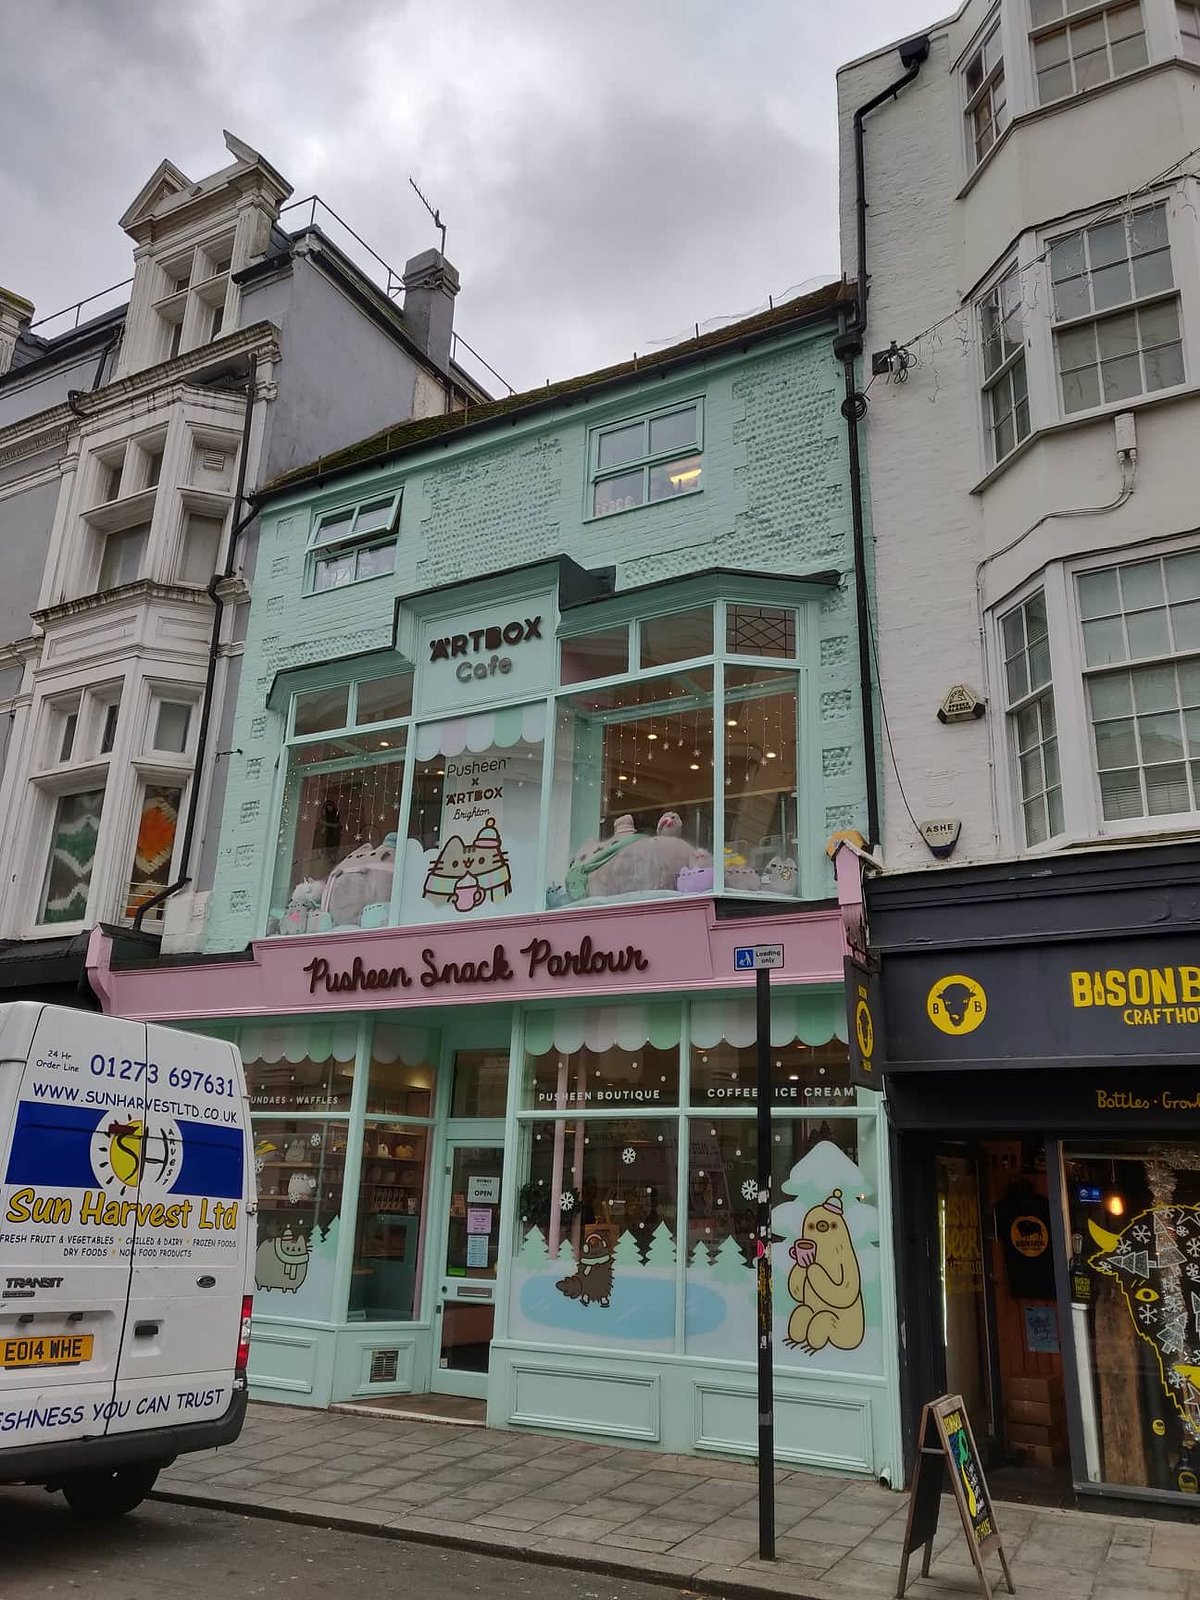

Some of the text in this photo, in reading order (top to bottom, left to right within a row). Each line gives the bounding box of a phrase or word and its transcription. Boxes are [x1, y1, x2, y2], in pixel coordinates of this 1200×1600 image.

[429, 615, 543, 662] ARTBOX
[456, 654, 513, 683] Cafe
[446, 759, 507, 778] Pusheen
[445, 786, 503, 806] ARTBOX
[453, 806, 490, 821] Brighton
[925, 823, 954, 833] ASHE
[303, 935, 649, 994] Pusheen Snack Parlour
[1123, 1007, 1200, 1025] CRAFTHO
[48, 1049, 72, 1060] 24 Hr
[36, 1059, 80, 1073] Order Line
[90, 1053, 234, 1098] 01273 697631
[251, 1095, 339, 1104] UNDAES WAFFLES
[539, 1089, 660, 1102] PUSHEEN BOUTIQUE
[707, 1086, 854, 1098] COFFEE ICE CREAM
[1096, 1090, 1150, 1109] Bottles
[474, 1189, 493, 1197] OPEN
[6, 1187, 238, 1230] Sun Harvest Ltd
[0, 1234, 237, 1248] FRESH FRUIT & VEGETABLES CHILLED & DAIRY FROZEN FOODS
[63, 1247, 192, 1258] DRY FOODS NON FOOD PRODUCTS
[6, 1277, 64, 1288] TRANSIT
[50, 1338, 83, 1358] WHE
[93, 1400, 130, 1421] YOU
[136, 1396, 170, 1414] CAN
[177, 1389, 224, 1408] TRUST
